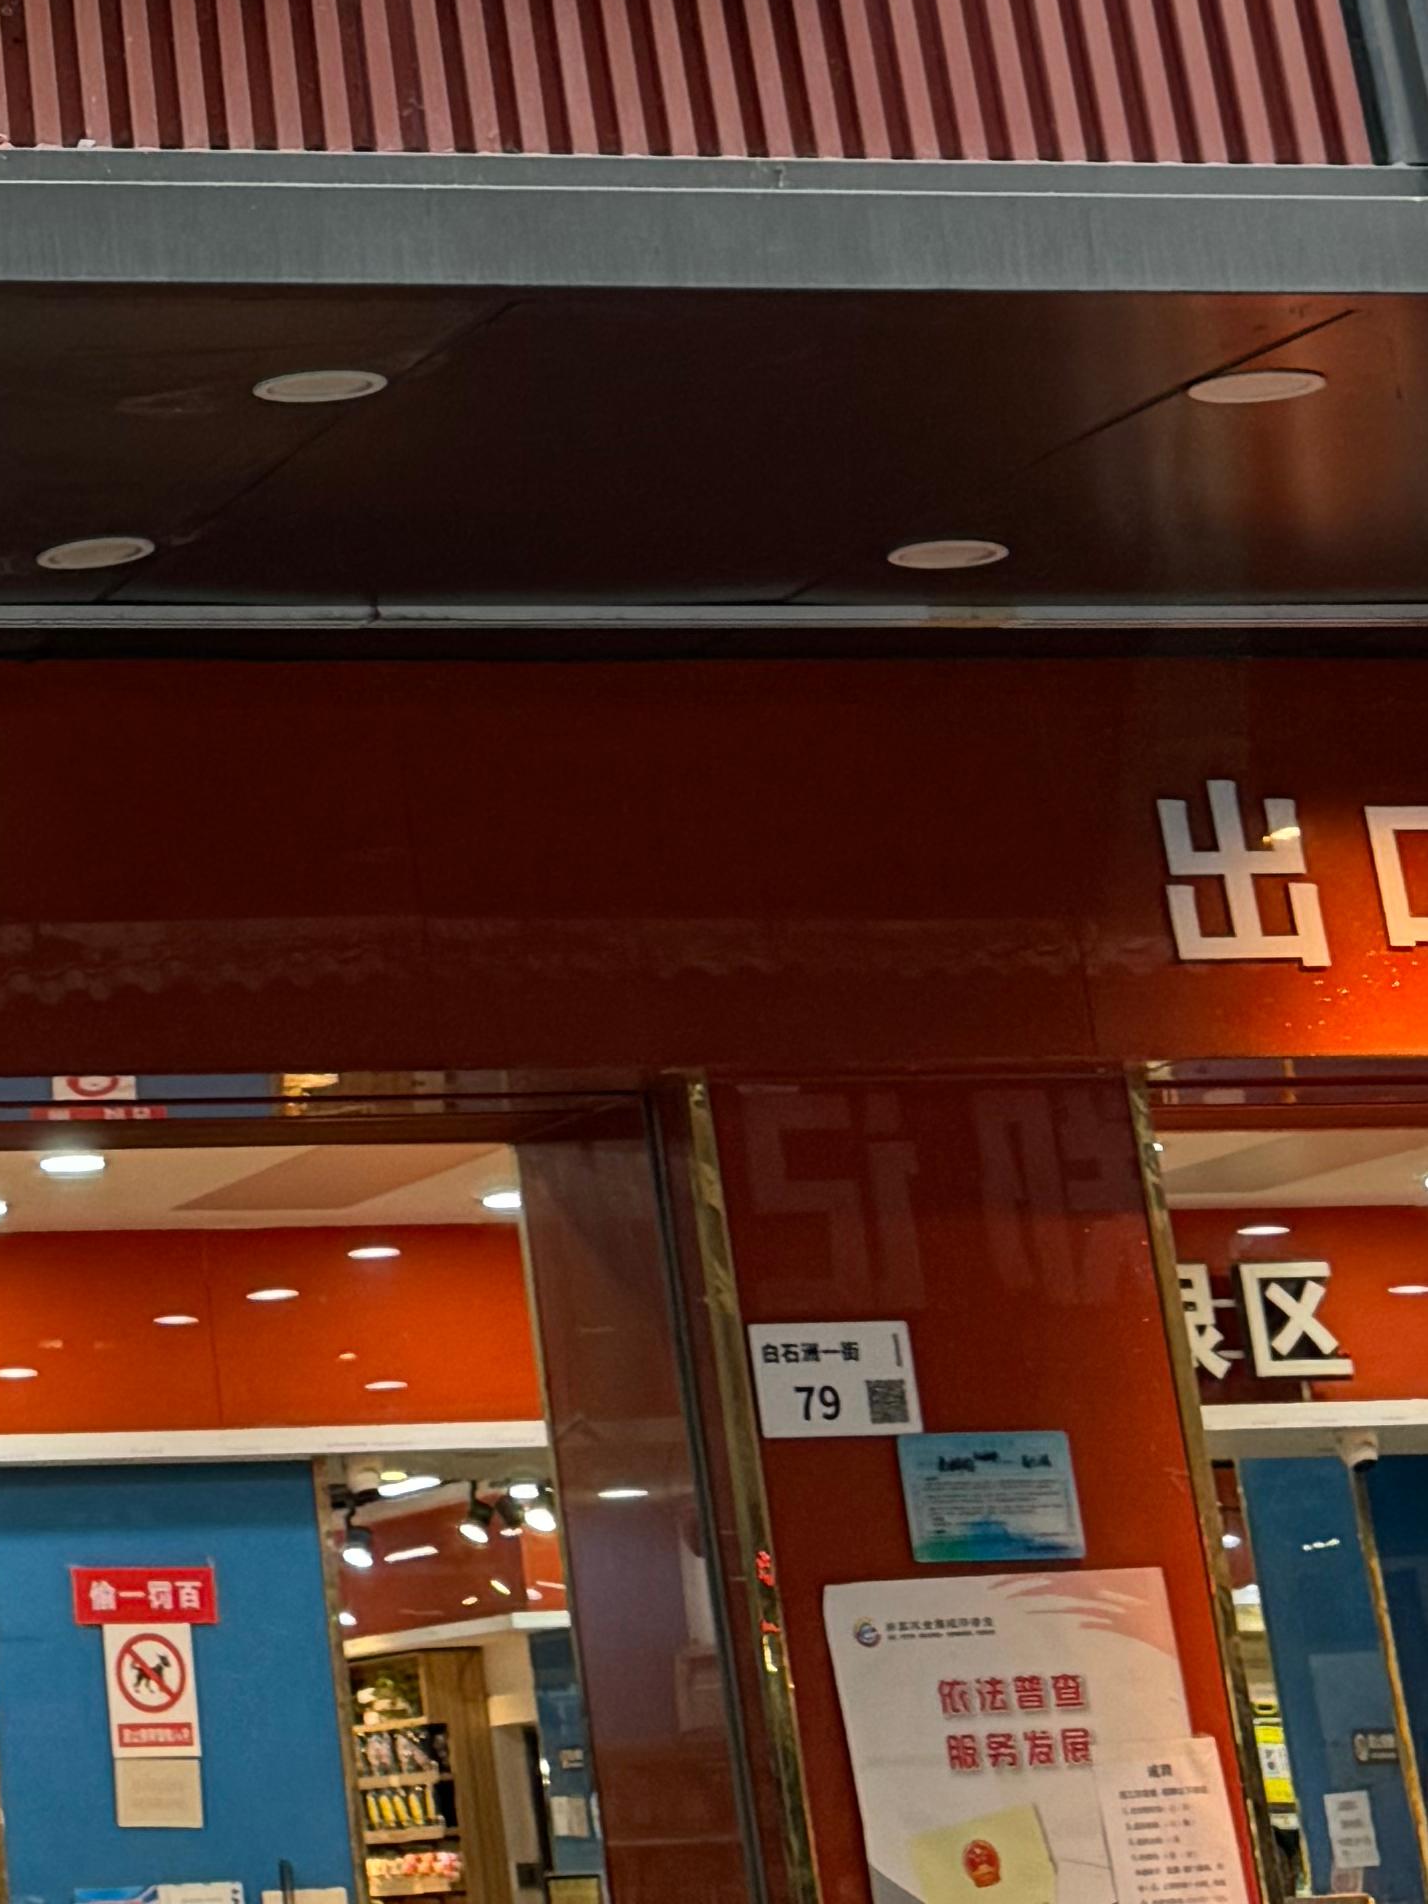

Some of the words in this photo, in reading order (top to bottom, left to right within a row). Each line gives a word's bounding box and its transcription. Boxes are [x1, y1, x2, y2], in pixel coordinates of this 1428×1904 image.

[793, 1384, 842, 1422] 79
[937, 1673, 1087, 1716] 依法普查
[946, 1727, 1094, 1771] 服务发展
